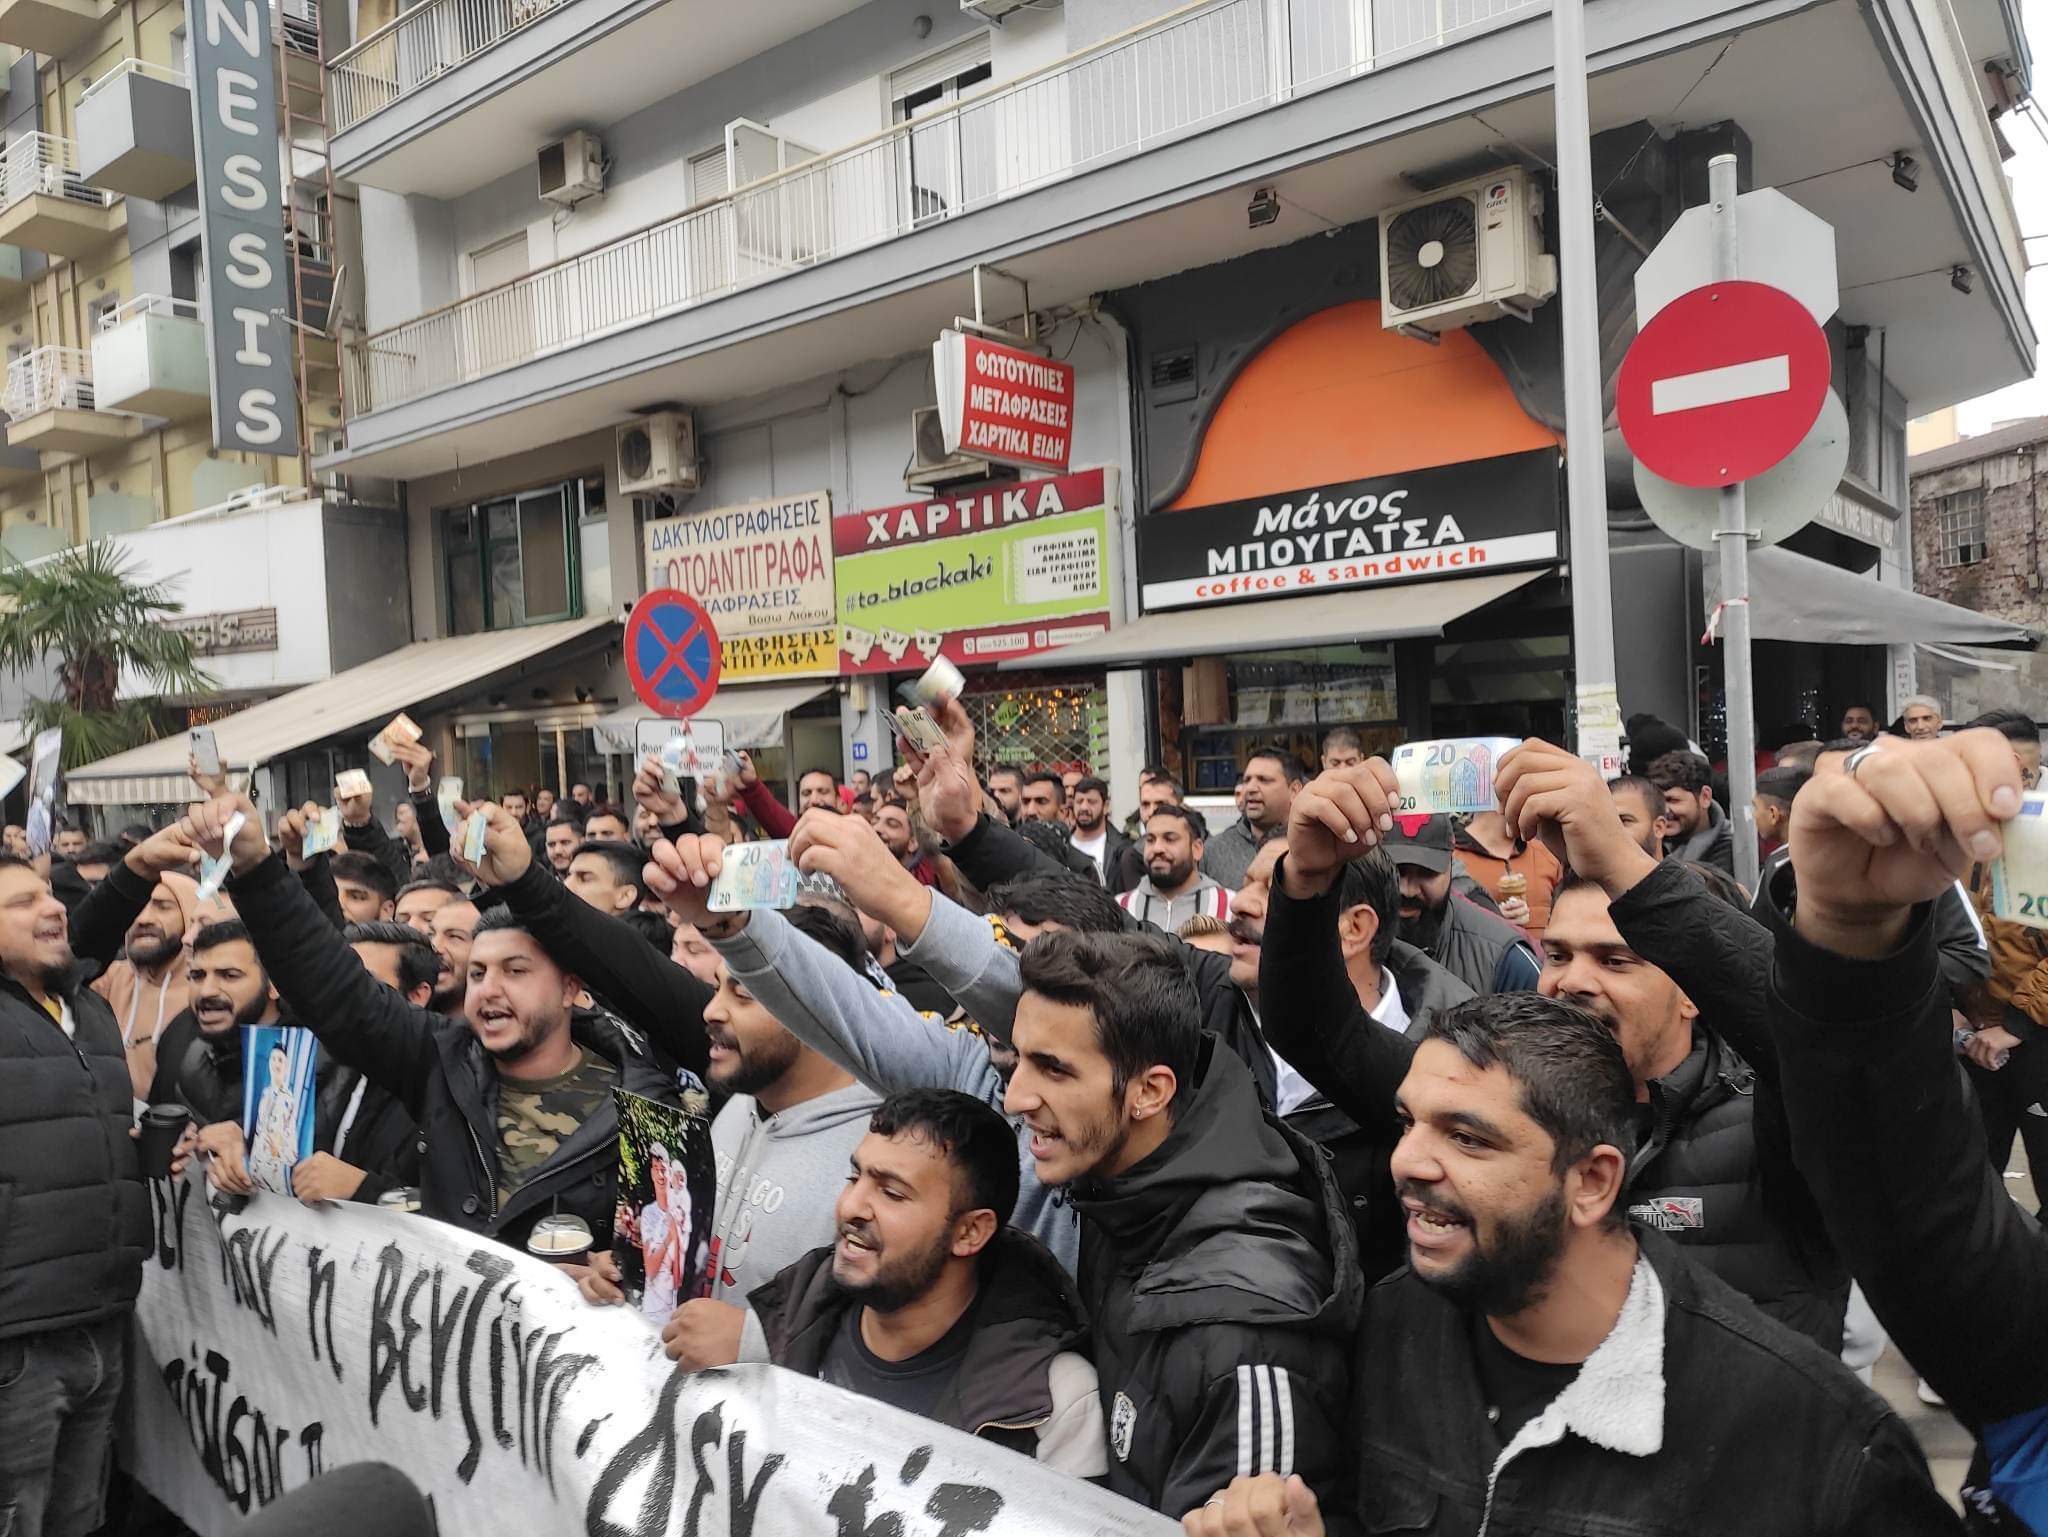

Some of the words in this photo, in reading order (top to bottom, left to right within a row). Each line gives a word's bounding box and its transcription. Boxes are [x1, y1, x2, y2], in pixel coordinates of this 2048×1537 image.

[975, 349, 1065, 394] ΦΩΤΟΤΥΠΙΕΣ
[970, 384, 1068, 428] ΜΕΤΑΦΡΑΣΕΙΣ
[967, 420, 1029, 455] ΧΑΡΤΙΚΑ
[1032, 433, 1065, 461] ΕΙΔΗ
[652, 499, 821, 551] ΔΑΚΤΥΛΟΓΡΑΦΗΣΕΙΣ
[866, 483, 1064, 545] ΧΑΡΤΙΚΑ
[1252, 489, 1408, 537] Μάνος
[667, 534, 826, 597] ΩΤΟΑΝΤΙΓΡΑΦΑ
[1207, 514, 1465, 576] ΜΠΟΥΓΑΤΣΑ
[1195, 573, 1287, 599] coffee
[1298, 568, 1316, 585] &
[1328, 546, 1488, 581] sandwich
[701, 588, 802, 615] ΤΑΦΡΑΣΕΙΣ
[720, 629, 835, 655] ΓΡΑΦΗΣΕΙΣ
[720, 648, 818, 670] ΝΤΙΓΡΑΦΑ
[1426, 743, 1456, 766] 20
[1400, 796, 1416, 809] 20
[740, 846, 761, 866] 20
[719, 892, 731, 905] 20
